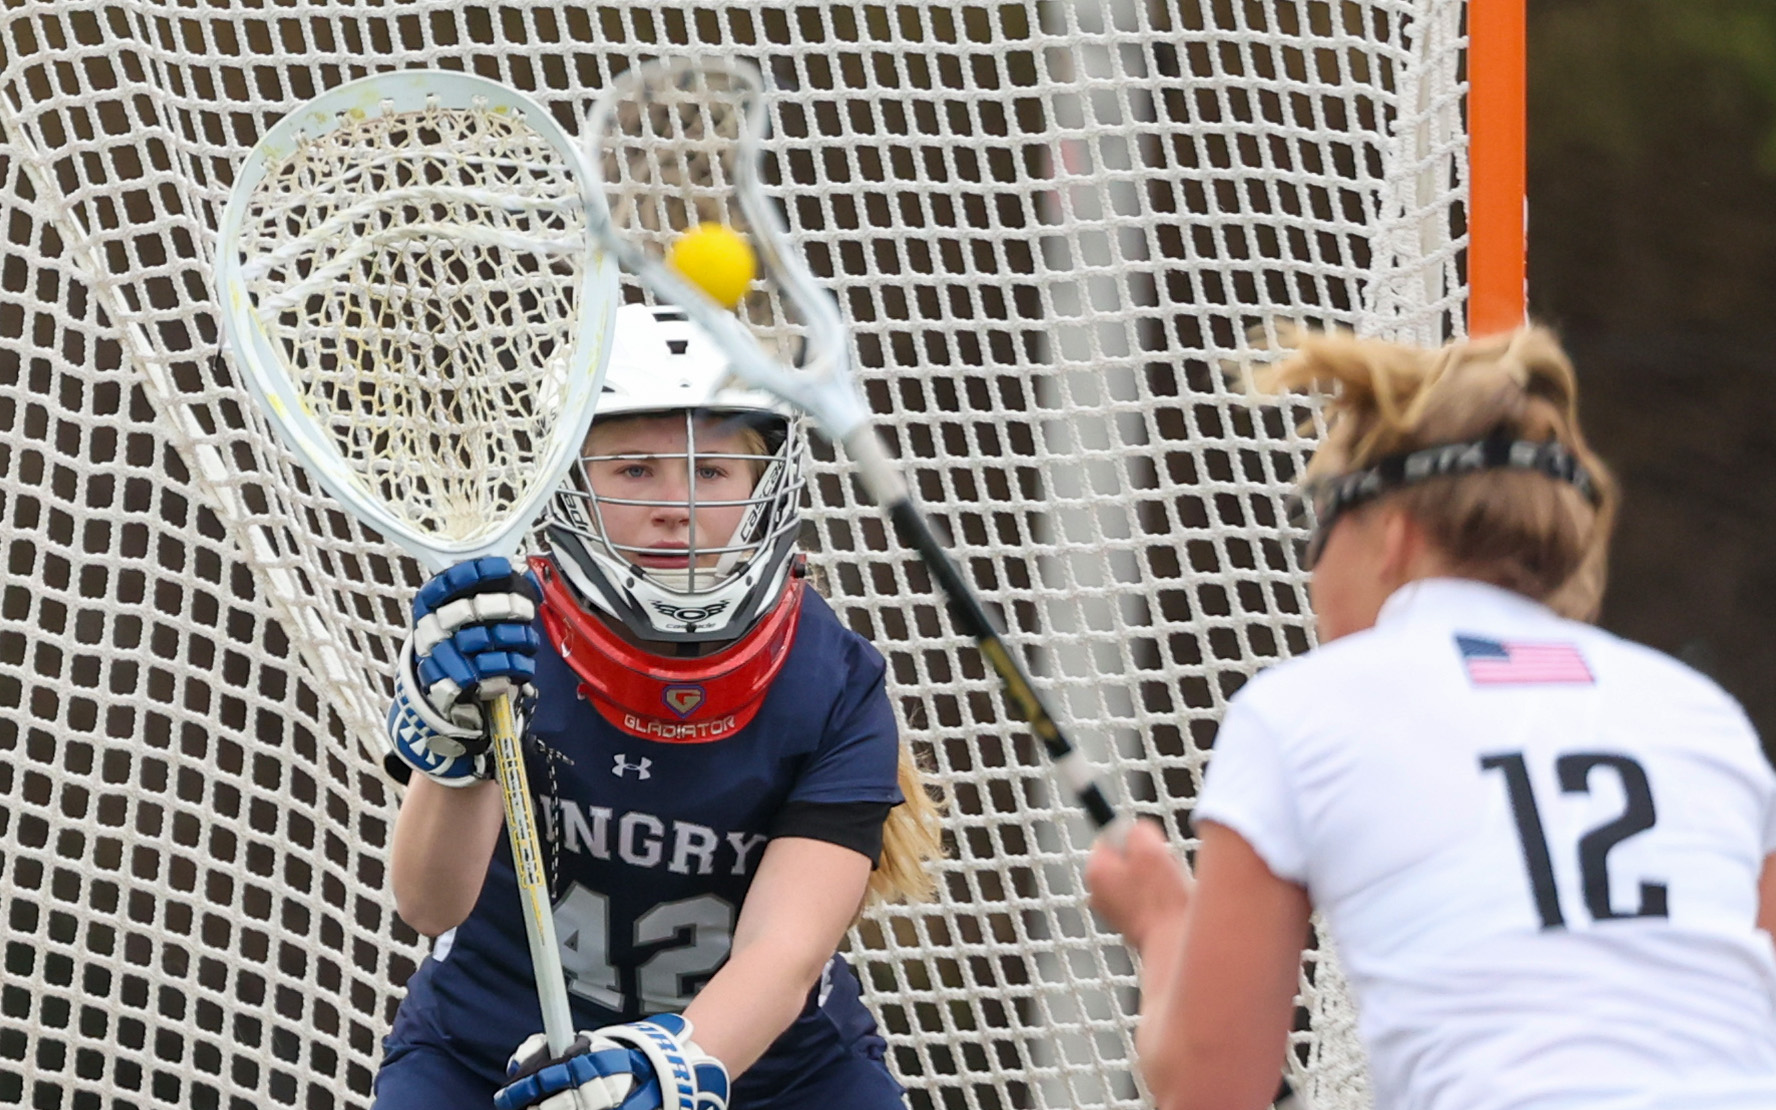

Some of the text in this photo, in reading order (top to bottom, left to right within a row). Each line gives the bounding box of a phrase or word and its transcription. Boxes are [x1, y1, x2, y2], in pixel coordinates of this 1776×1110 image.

[624, 714, 735, 738] GLADIATOR
[532, 794, 767, 876] INGRY
[1479, 752, 1669, 931] 12
[550, 881, 735, 1014] 42
